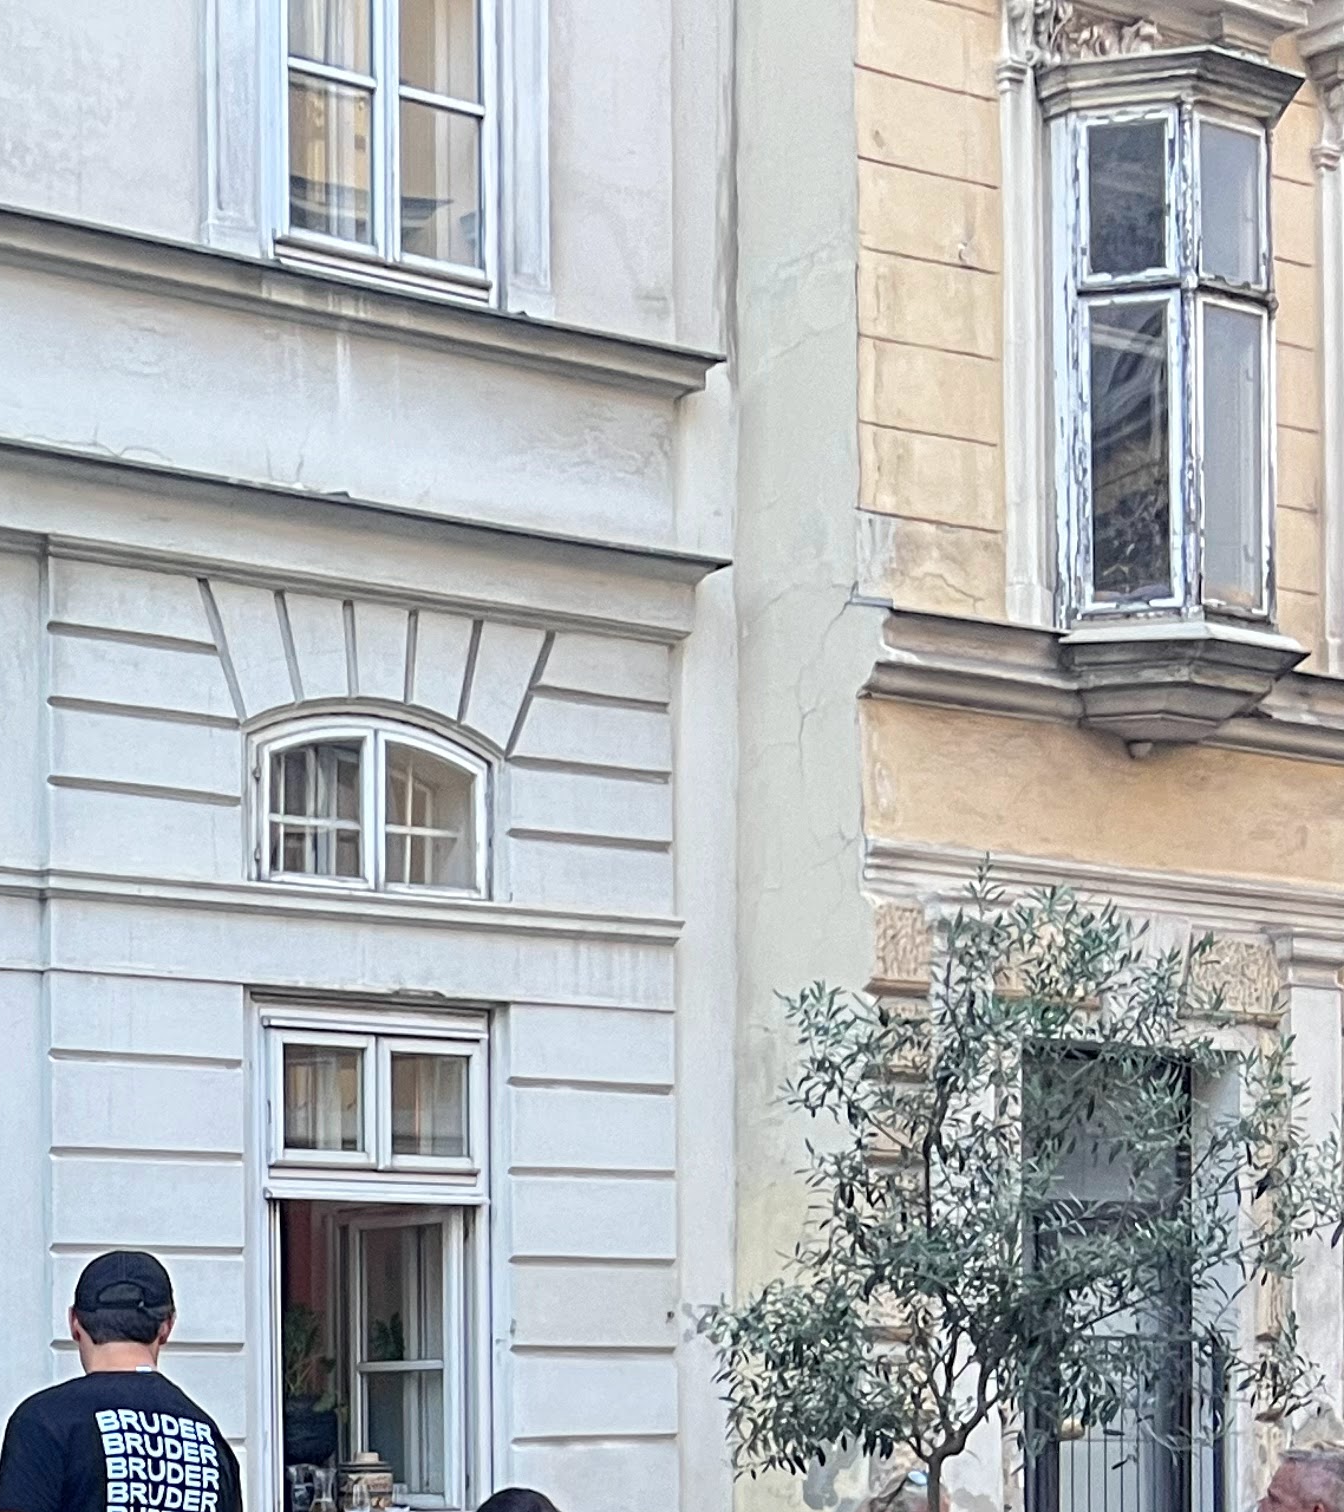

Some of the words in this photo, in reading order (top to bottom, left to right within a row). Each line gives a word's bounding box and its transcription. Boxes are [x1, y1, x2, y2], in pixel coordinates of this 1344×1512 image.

[95, 1409, 215, 1446] BRUDER
[101, 1432, 219, 1467] BRUDER
[106, 1457, 220, 1490] BRUDER
